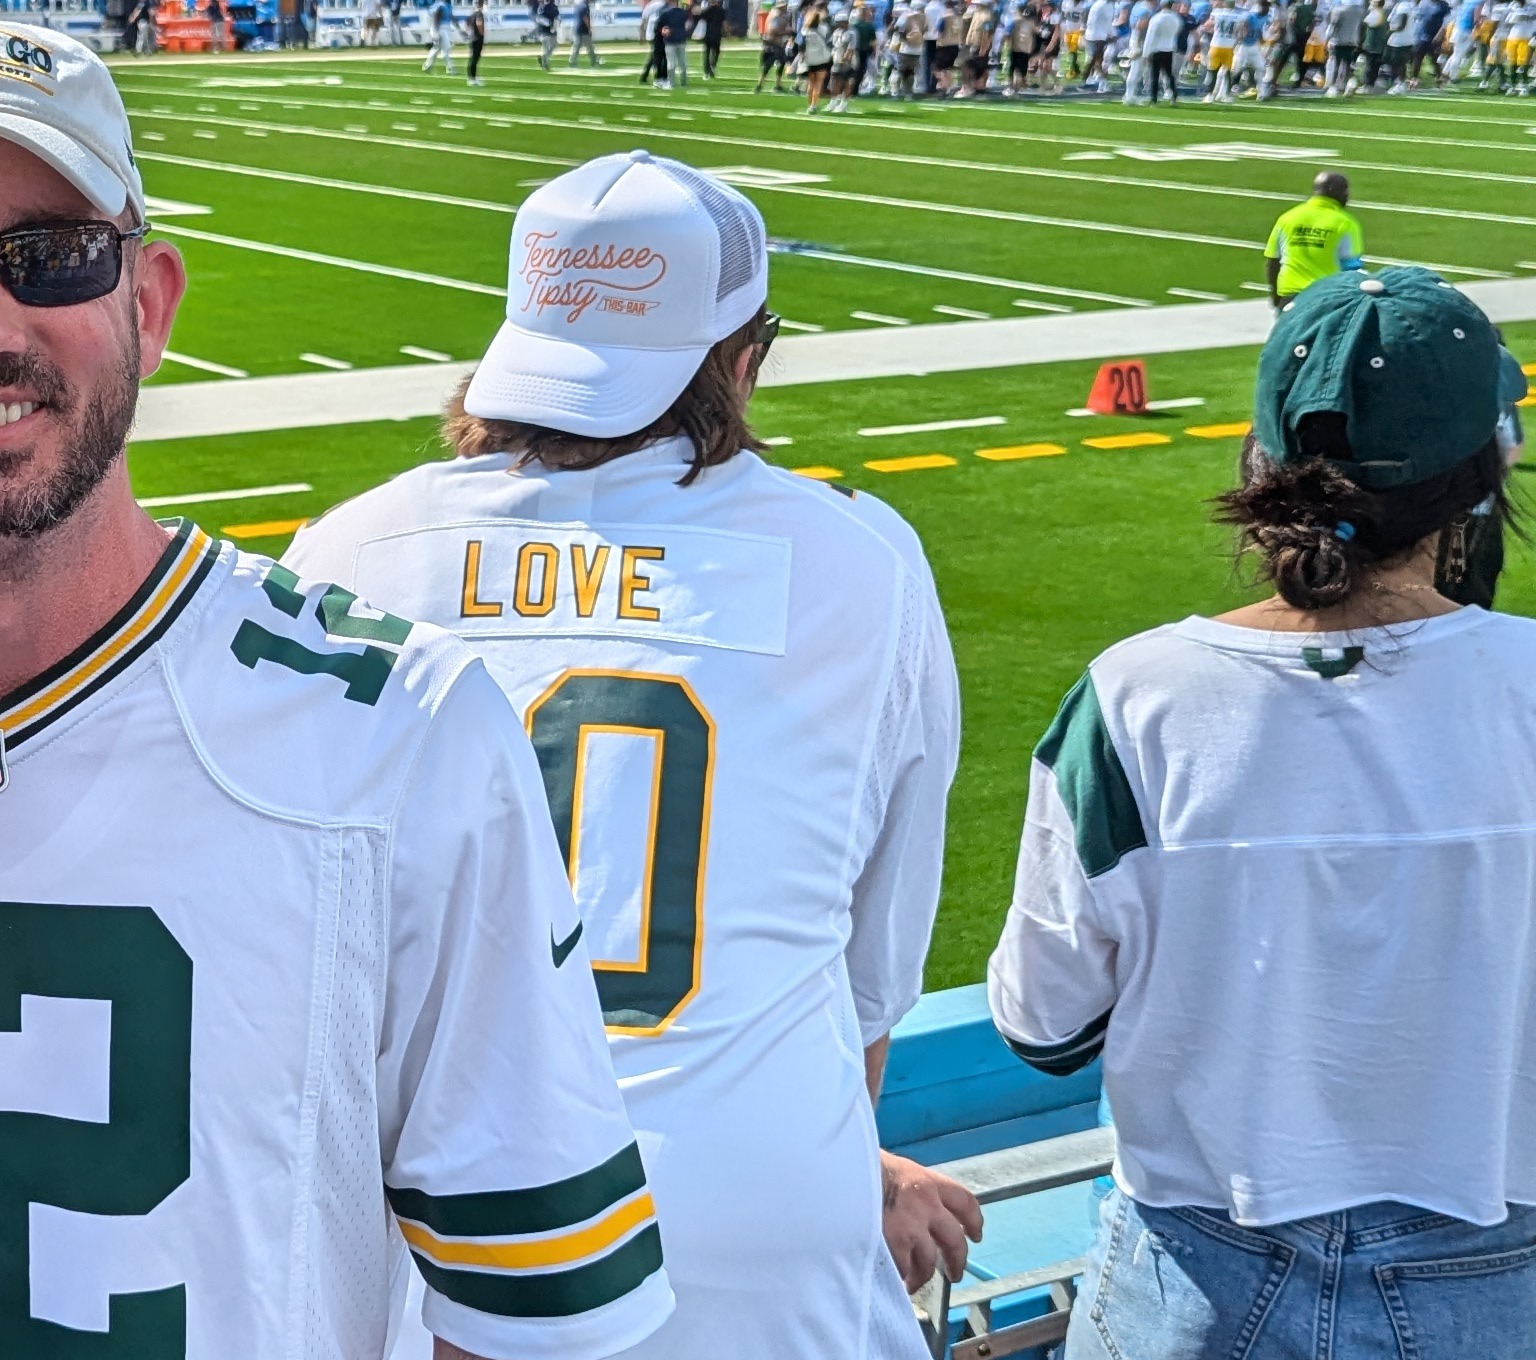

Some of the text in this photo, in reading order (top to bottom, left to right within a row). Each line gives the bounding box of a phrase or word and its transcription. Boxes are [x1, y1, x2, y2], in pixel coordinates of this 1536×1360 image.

[6, 36, 52, 73] GO
[519, 231, 666, 280] Tennessee
[521, 269, 598, 323] Tipsy
[604, 298, 646, 316] THIS BAR
[1110, 365, 1144, 412] 20
[461, 539, 664, 622] LOVE
